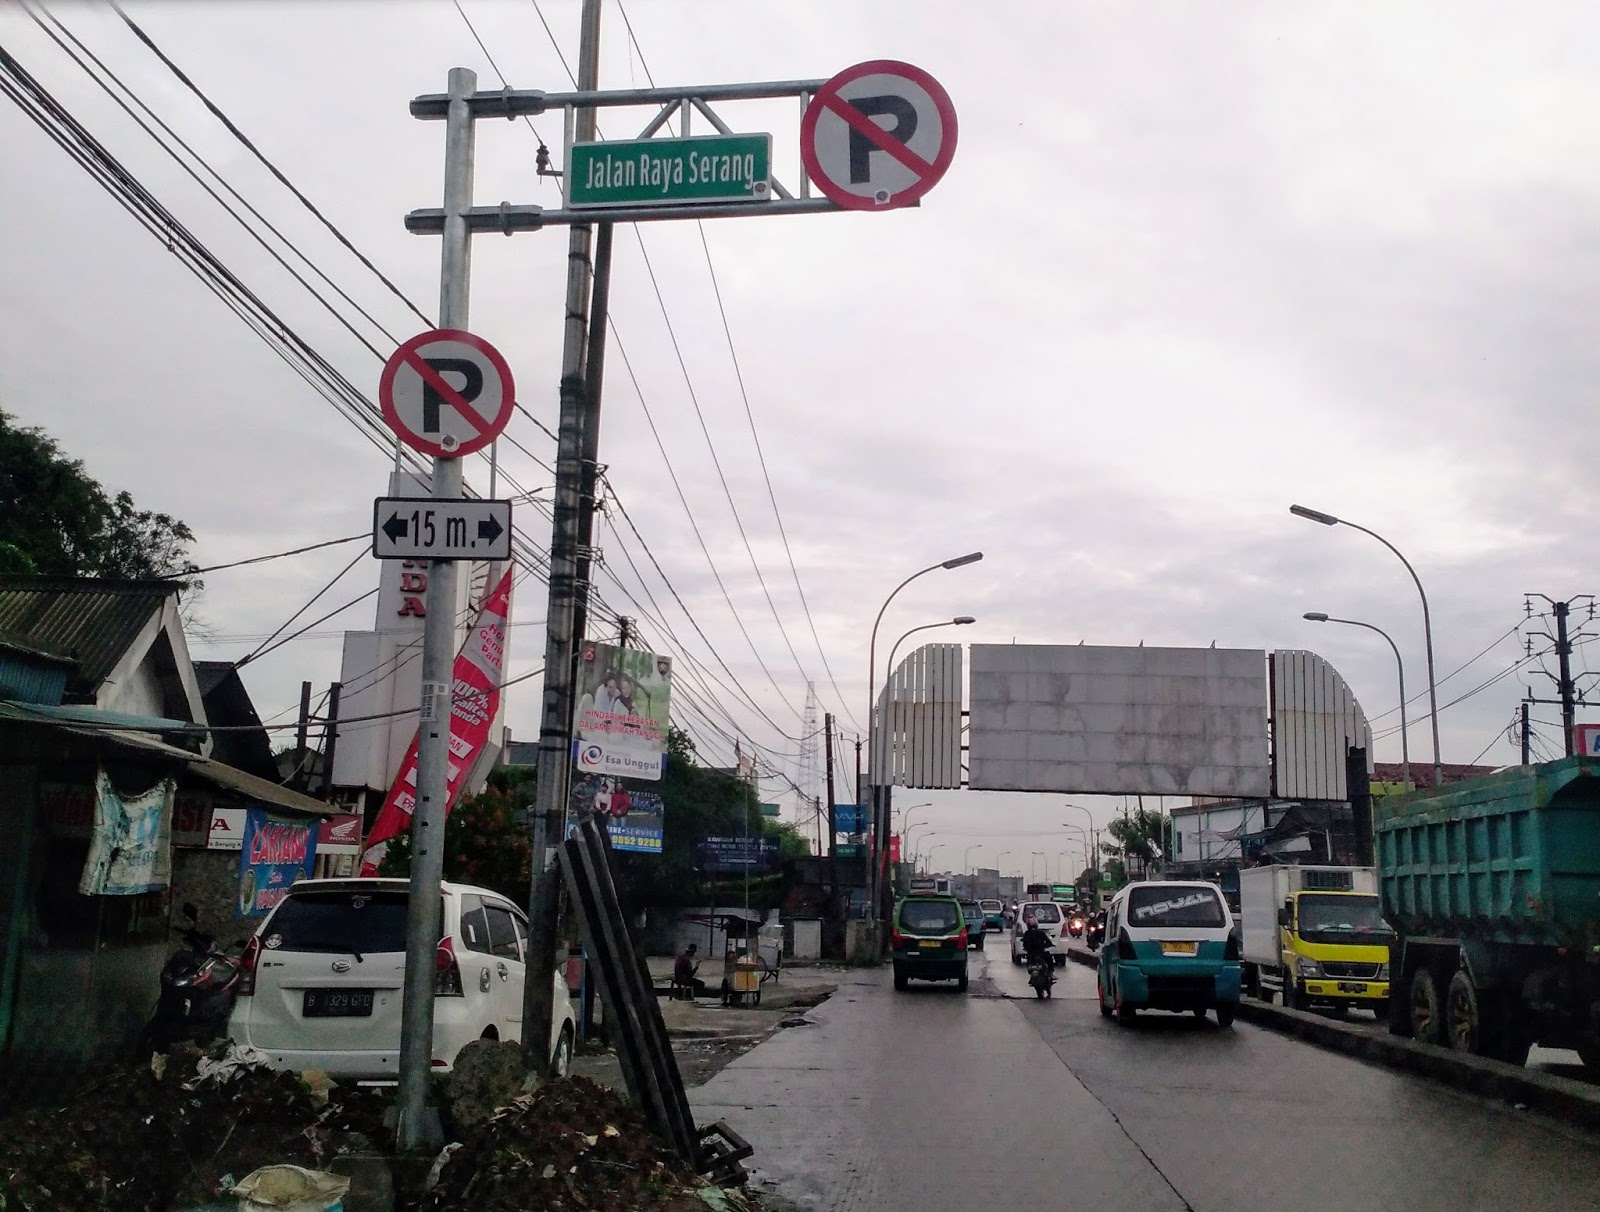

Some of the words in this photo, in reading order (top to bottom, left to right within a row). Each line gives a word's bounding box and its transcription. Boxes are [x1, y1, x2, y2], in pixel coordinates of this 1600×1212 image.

[586, 154, 635, 190] Jalan
[640, 154, 684, 193] Raya
[689, 151, 754, 190] Serang
[411, 510, 436, 547] 15
[398, 559, 429, 617] DA
[579, 720, 607, 731] DALAM
[606, 755, 621, 765] Esa
[625, 758, 659, 770] Unggul
